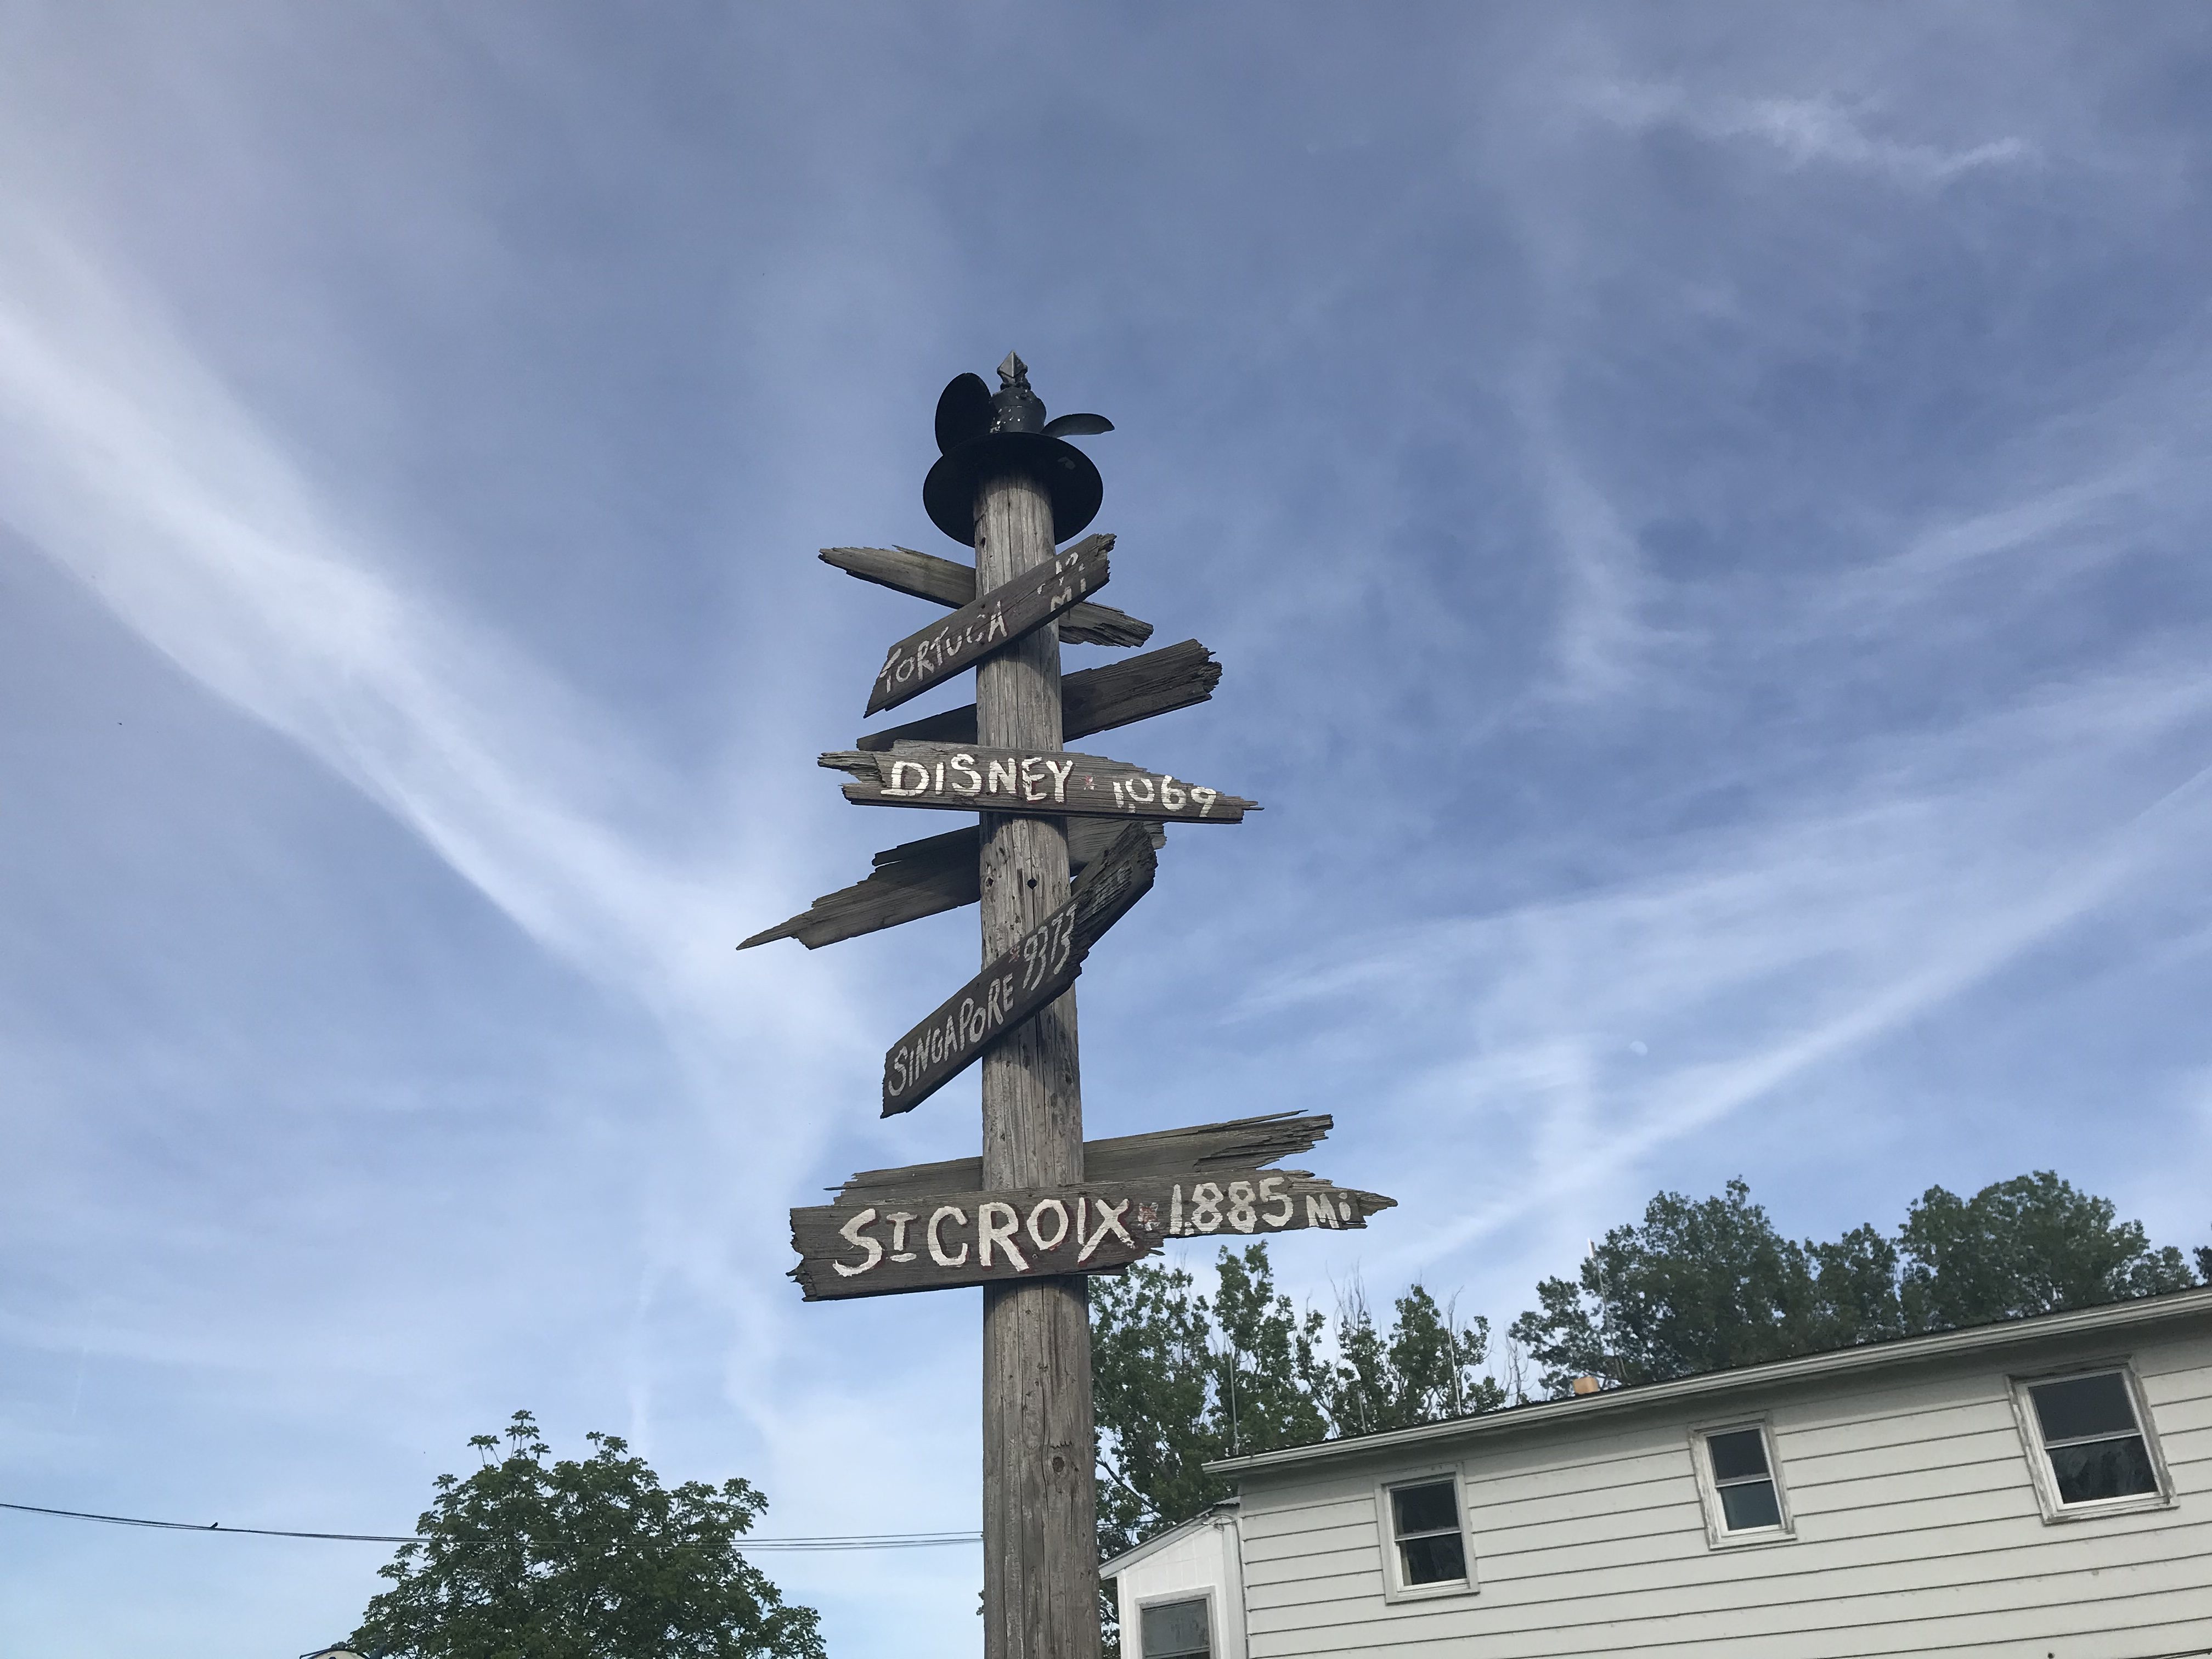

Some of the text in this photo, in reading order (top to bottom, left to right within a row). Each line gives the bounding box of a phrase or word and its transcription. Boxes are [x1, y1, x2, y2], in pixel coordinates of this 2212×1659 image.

[881, 753, 1073, 803] DISNEY
[888, 972, 1013, 1097] SINGAPORE
[927, 1197, 1136, 1272] CROIX
